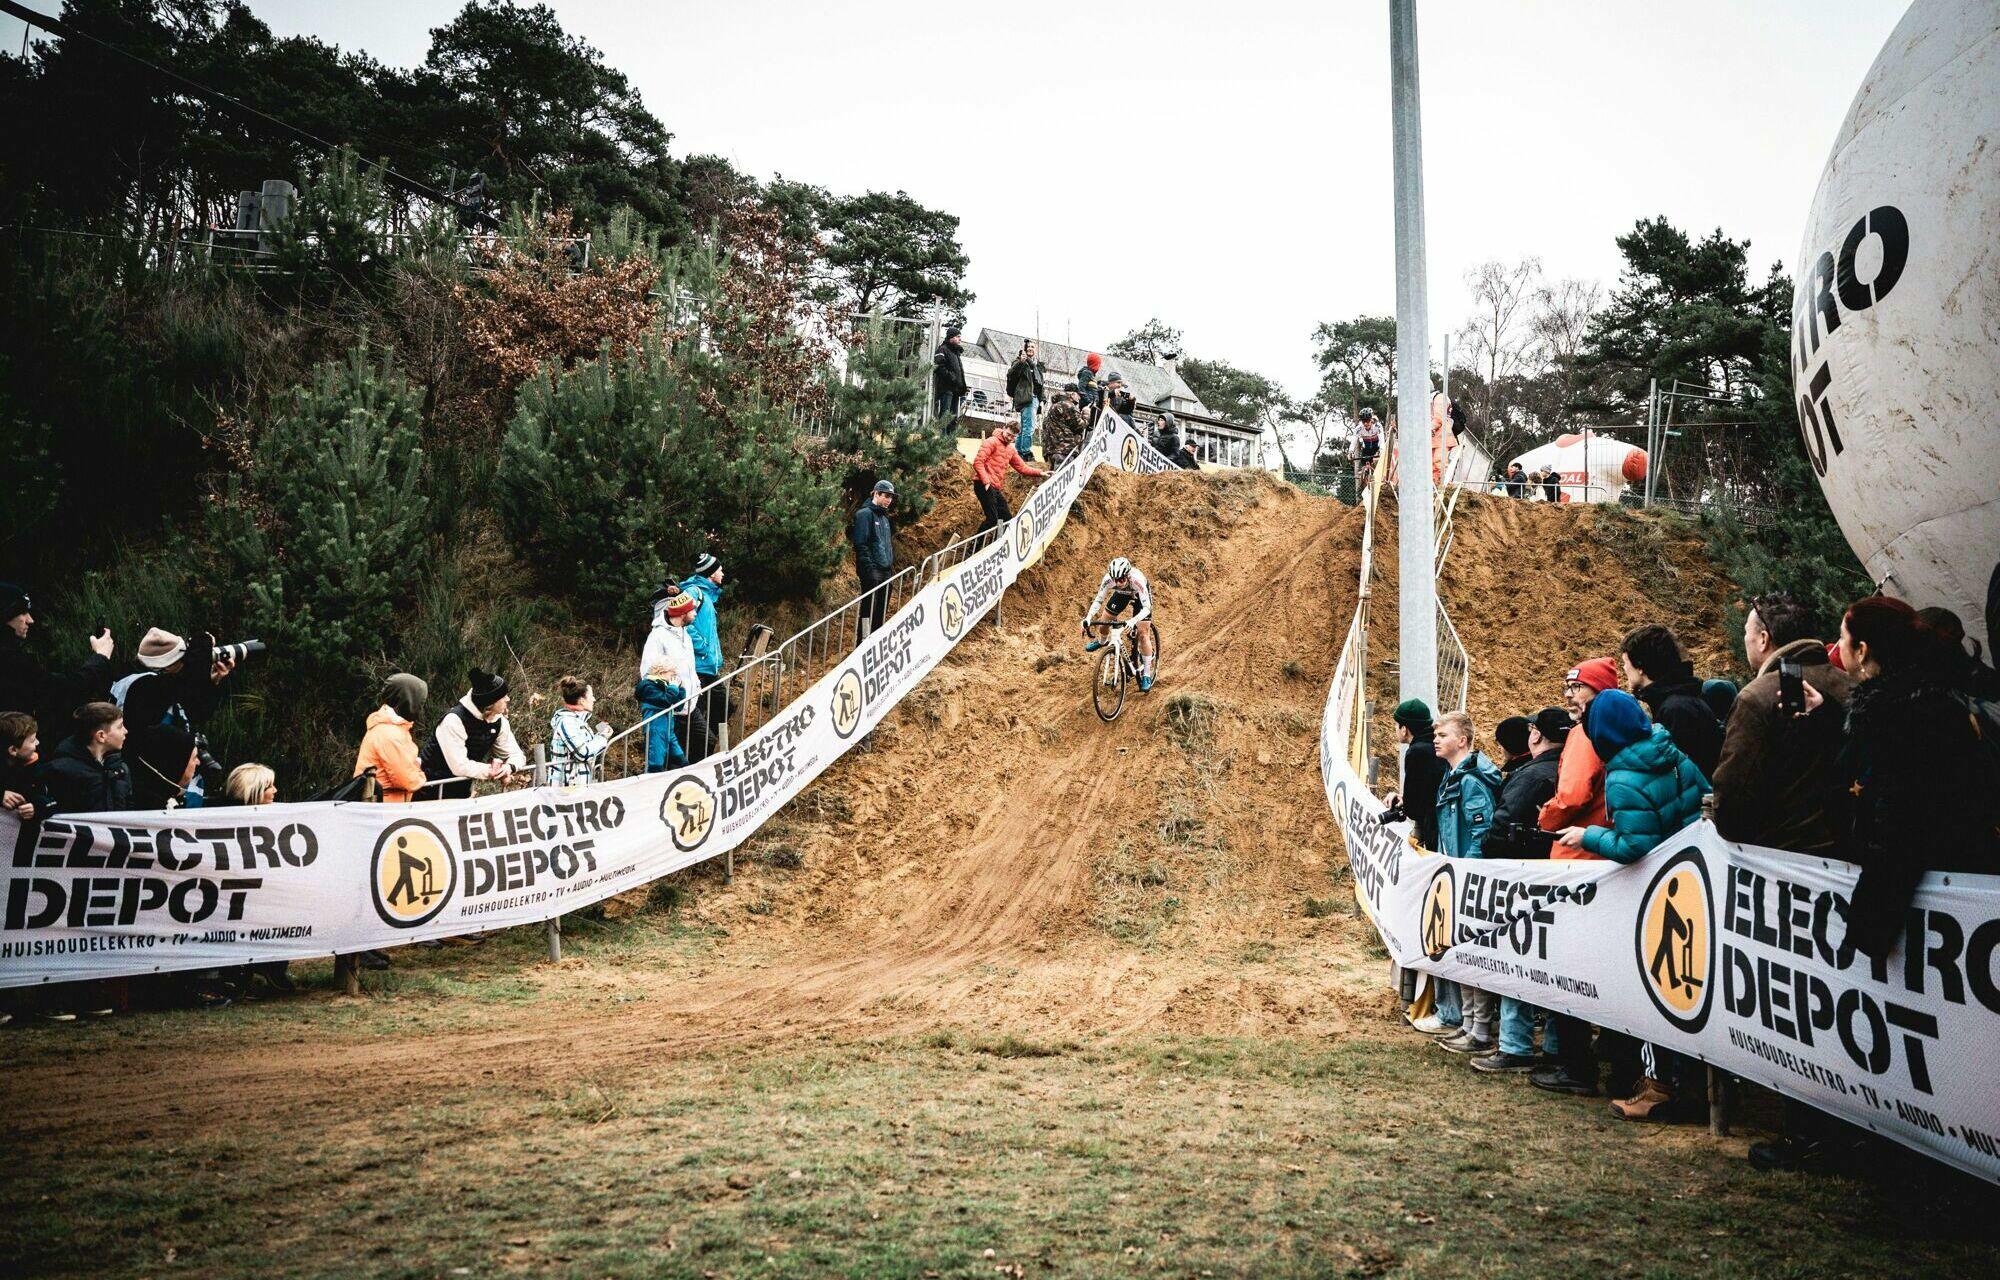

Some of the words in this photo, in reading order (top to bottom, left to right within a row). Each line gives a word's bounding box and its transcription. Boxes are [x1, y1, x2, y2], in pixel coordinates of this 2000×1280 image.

[862, 603, 925, 678] ELECTRO
[713, 704, 816, 787] ELECTRO
[720, 746, 796, 820] DEPOT
[12, 820, 319, 871] ELECTRO
[458, 795, 625, 852] ELECTRO
[460, 891, 547, 917] HUISHOUDELEKTRO
[556, 887, 566, 898] TV
[572, 878, 593, 893] AUDIO
[599, 864, 637, 884] MULTIMEDIA
[463, 839, 596, 897] DEPOT
[4, 877, 263, 931] DEPOT
[2, 935, 156, 958] HUISHOUDELEKTRO
[172, 934, 189, 945] TV
[200, 930, 237, 944] AUDIO
[250, 925, 312, 942] MULTIMEDIA
[1515, 964, 1523, 979] TV
[1530, 968, 1550, 986] AUDIO
[1555, 974, 1600, 1000] MULTIMEDIA
[1722, 943, 1939, 1096] DEPOT
[1728, 1026, 1847, 1095] HUISHOUDELEKTRO
[1859, 1084, 1880, 1110] TV
[1896, 1099, 1945, 1137] AUDIO
